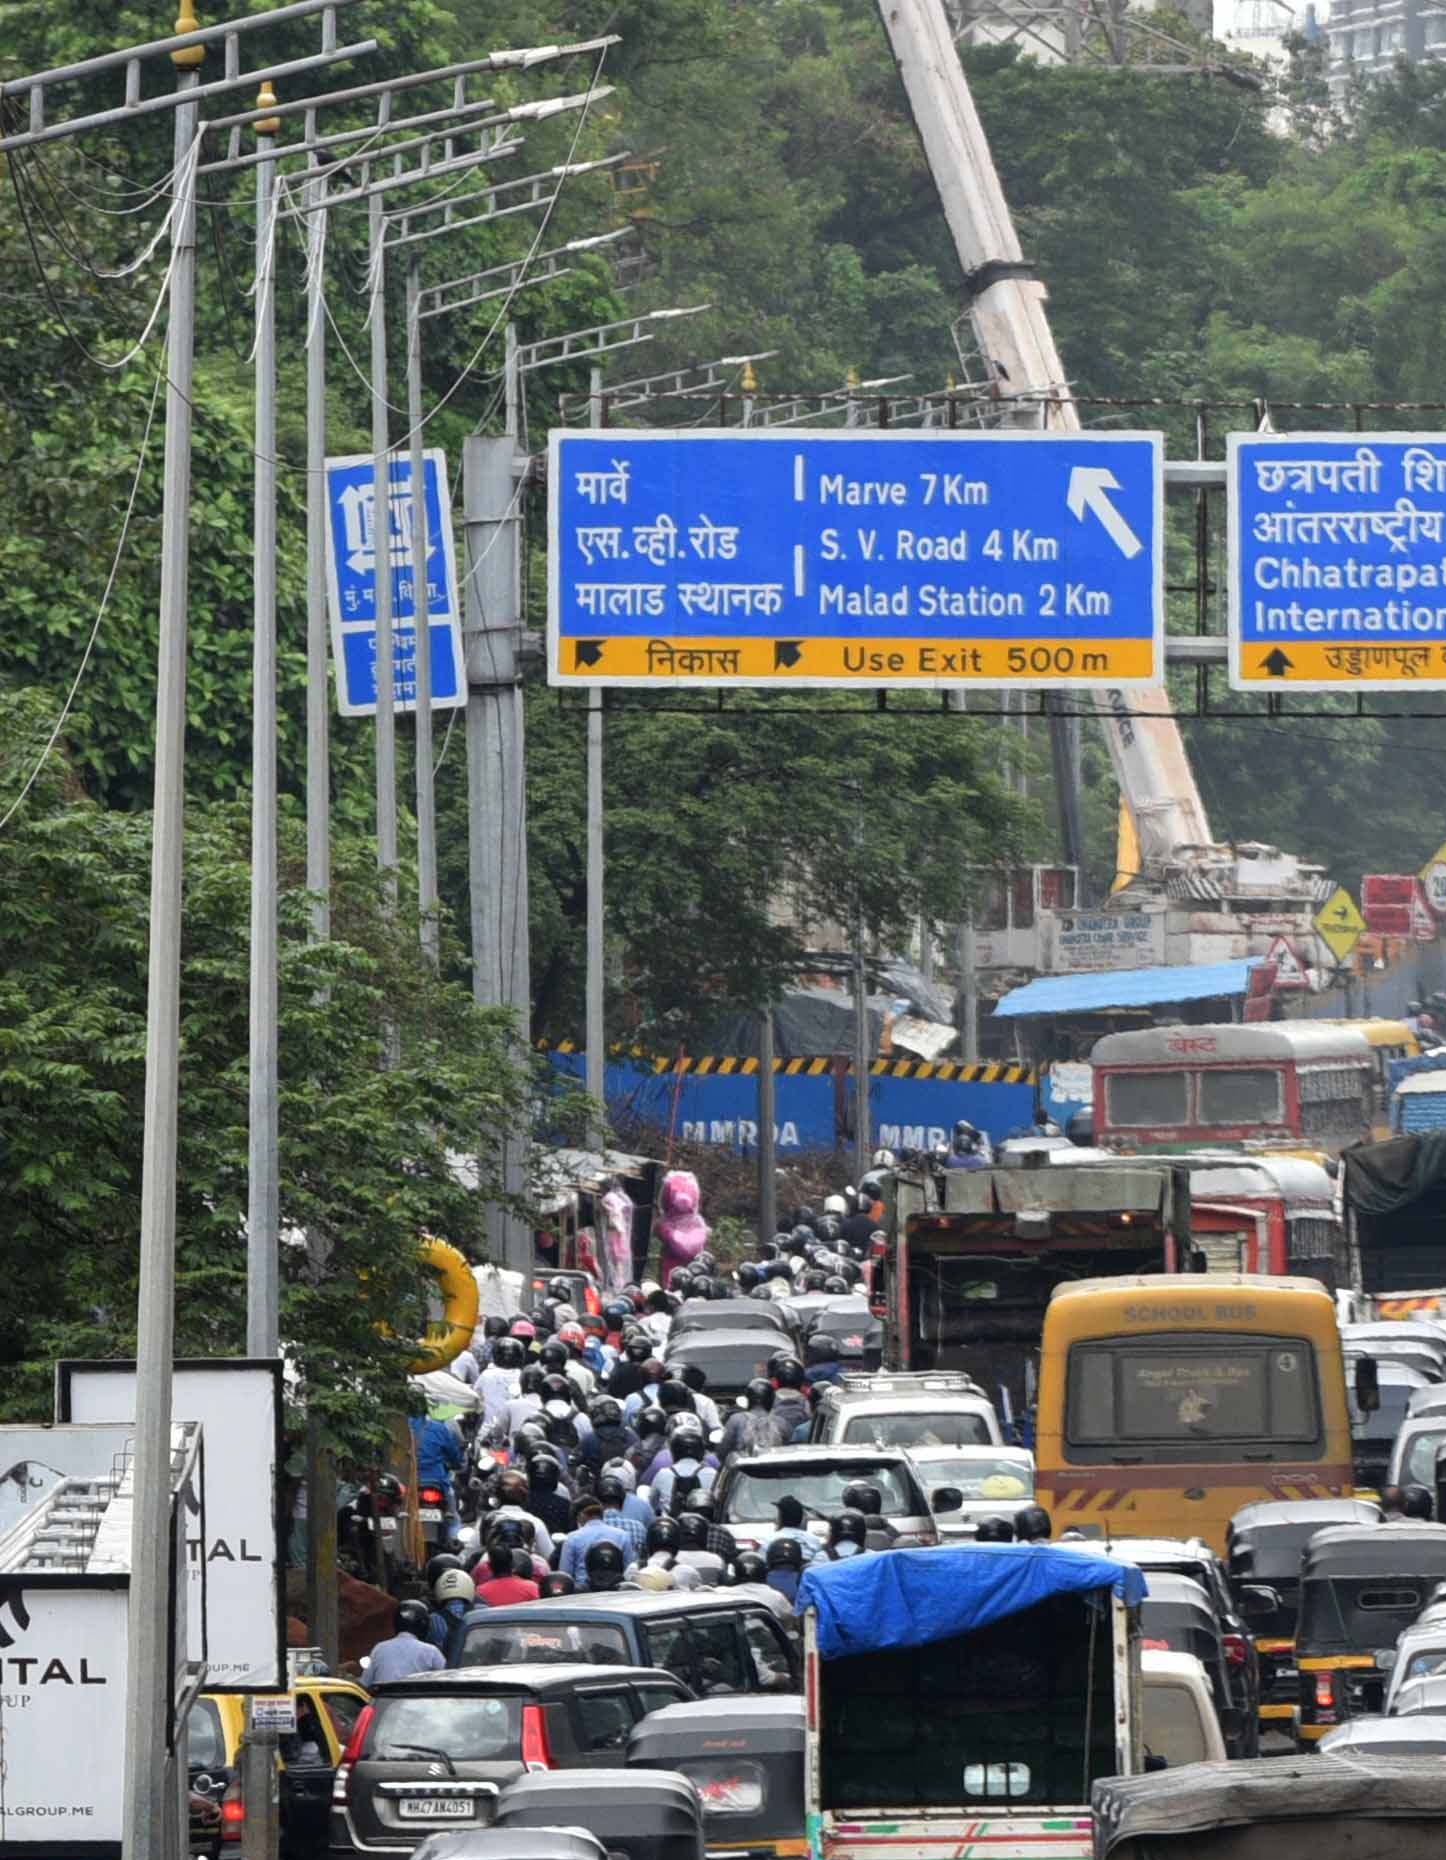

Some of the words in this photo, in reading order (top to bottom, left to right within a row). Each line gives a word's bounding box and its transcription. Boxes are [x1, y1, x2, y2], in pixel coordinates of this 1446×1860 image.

[576, 460, 629, 503] मार्वे
[1255, 446, 1382, 494] छत्रपती
[821, 475, 906, 504] Marve
[921, 474, 936, 504] 7
[944, 475, 987, 504] Km
[1254, 498, 1444, 552] आंतरराष्ट्रीय
[822, 529, 845, 559] S.
[859, 530, 882, 559] V.
[897, 530, 966, 560] Road
[983, 530, 1002, 560] 4
[1014, 530, 1057, 560] Km
[576, 584, 665, 615] मालाड
[678, 583, 783, 614] स्थानक
[821, 585, 907, 615] Malad
[920, 585, 1022, 615] Station
[1040, 584, 1055, 615] 2
[1066, 584, 1109, 615] Km
[646, 640, 740, 674] निकास
[844, 647, 904, 672] Use
[919, 648, 981, 672] Exit
[1008, 648, 1073, 672] 500
[1083, 654, 1107, 670] m
[683, 1119, 802, 1147] MMRA
[1123, 1303, 1206, 1324] SCHOOL
[1215, 1303, 1258, 1321] BUS
